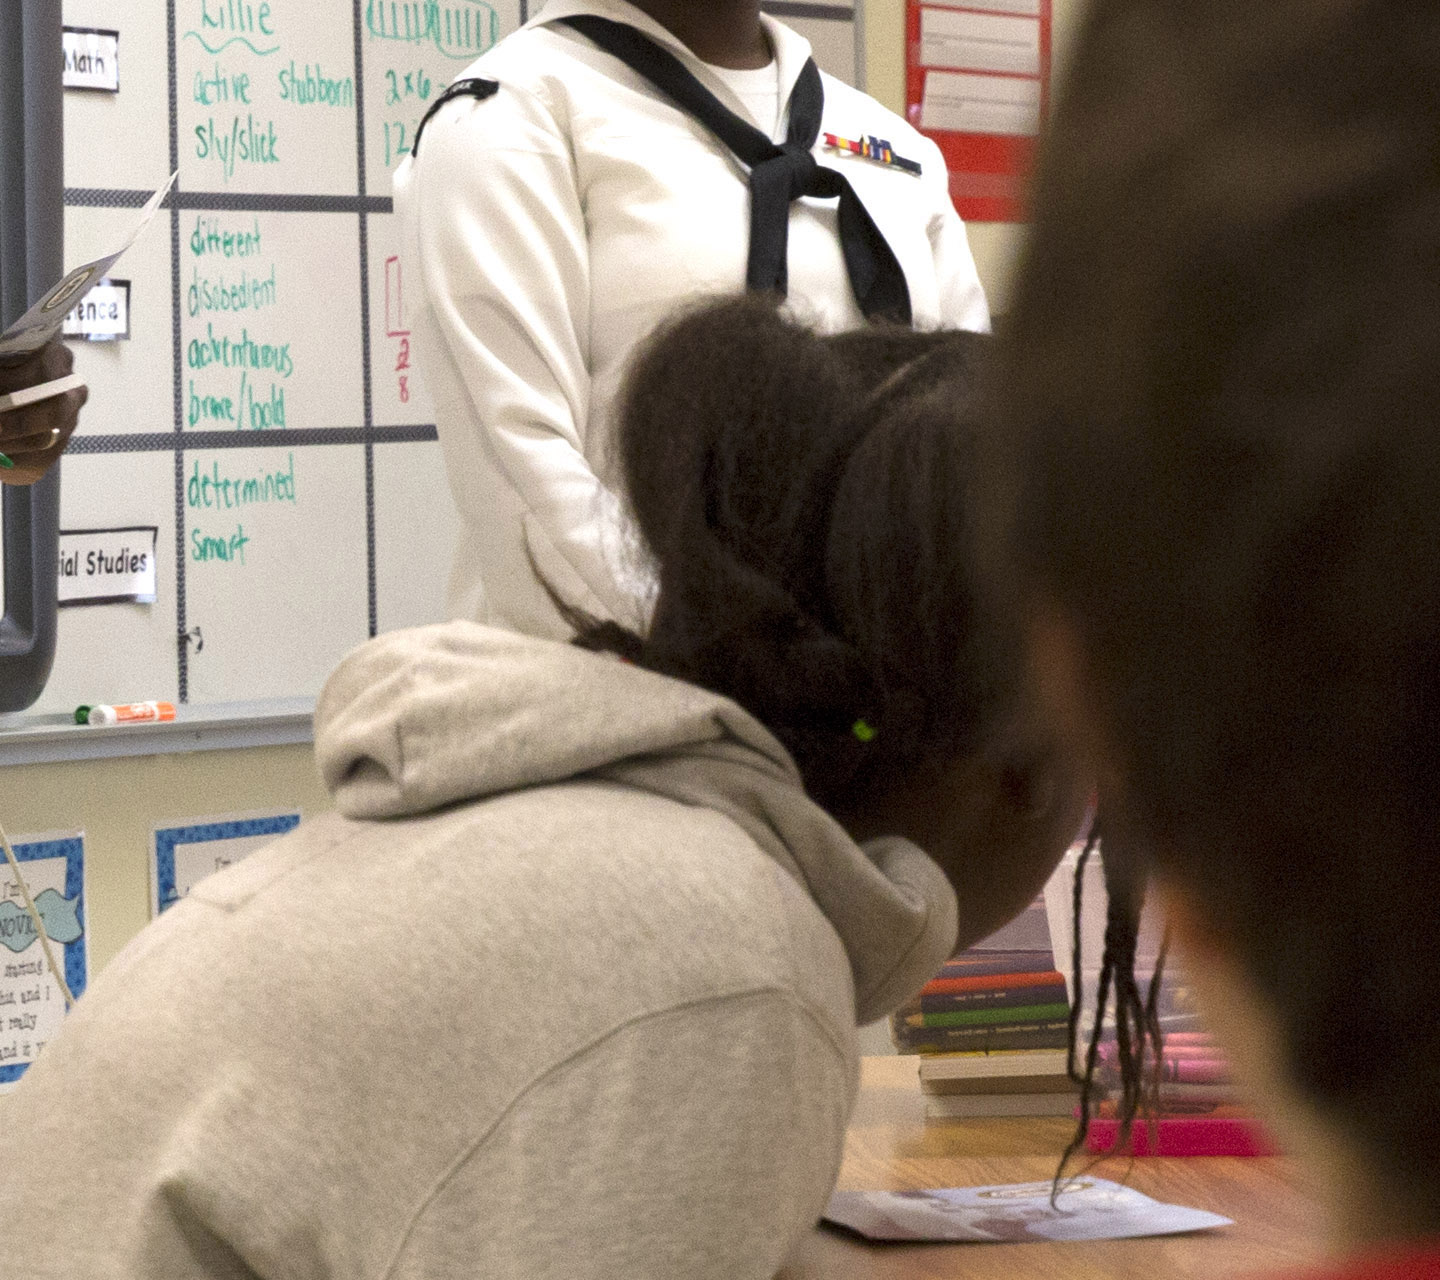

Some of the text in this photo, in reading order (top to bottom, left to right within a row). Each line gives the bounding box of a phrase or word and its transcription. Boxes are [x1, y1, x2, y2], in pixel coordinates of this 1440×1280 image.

[62, 47, 105, 75] Math
[194, 60, 354, 108] active stubborn
[194, 114, 280, 183] sly/slick
[190, 216, 261, 257] different
[188, 265, 276, 318] disobedient
[188, 322, 293, 378] adventurous
[188, 452, 296, 510] determined
[86, 547, 149, 577] Studies
